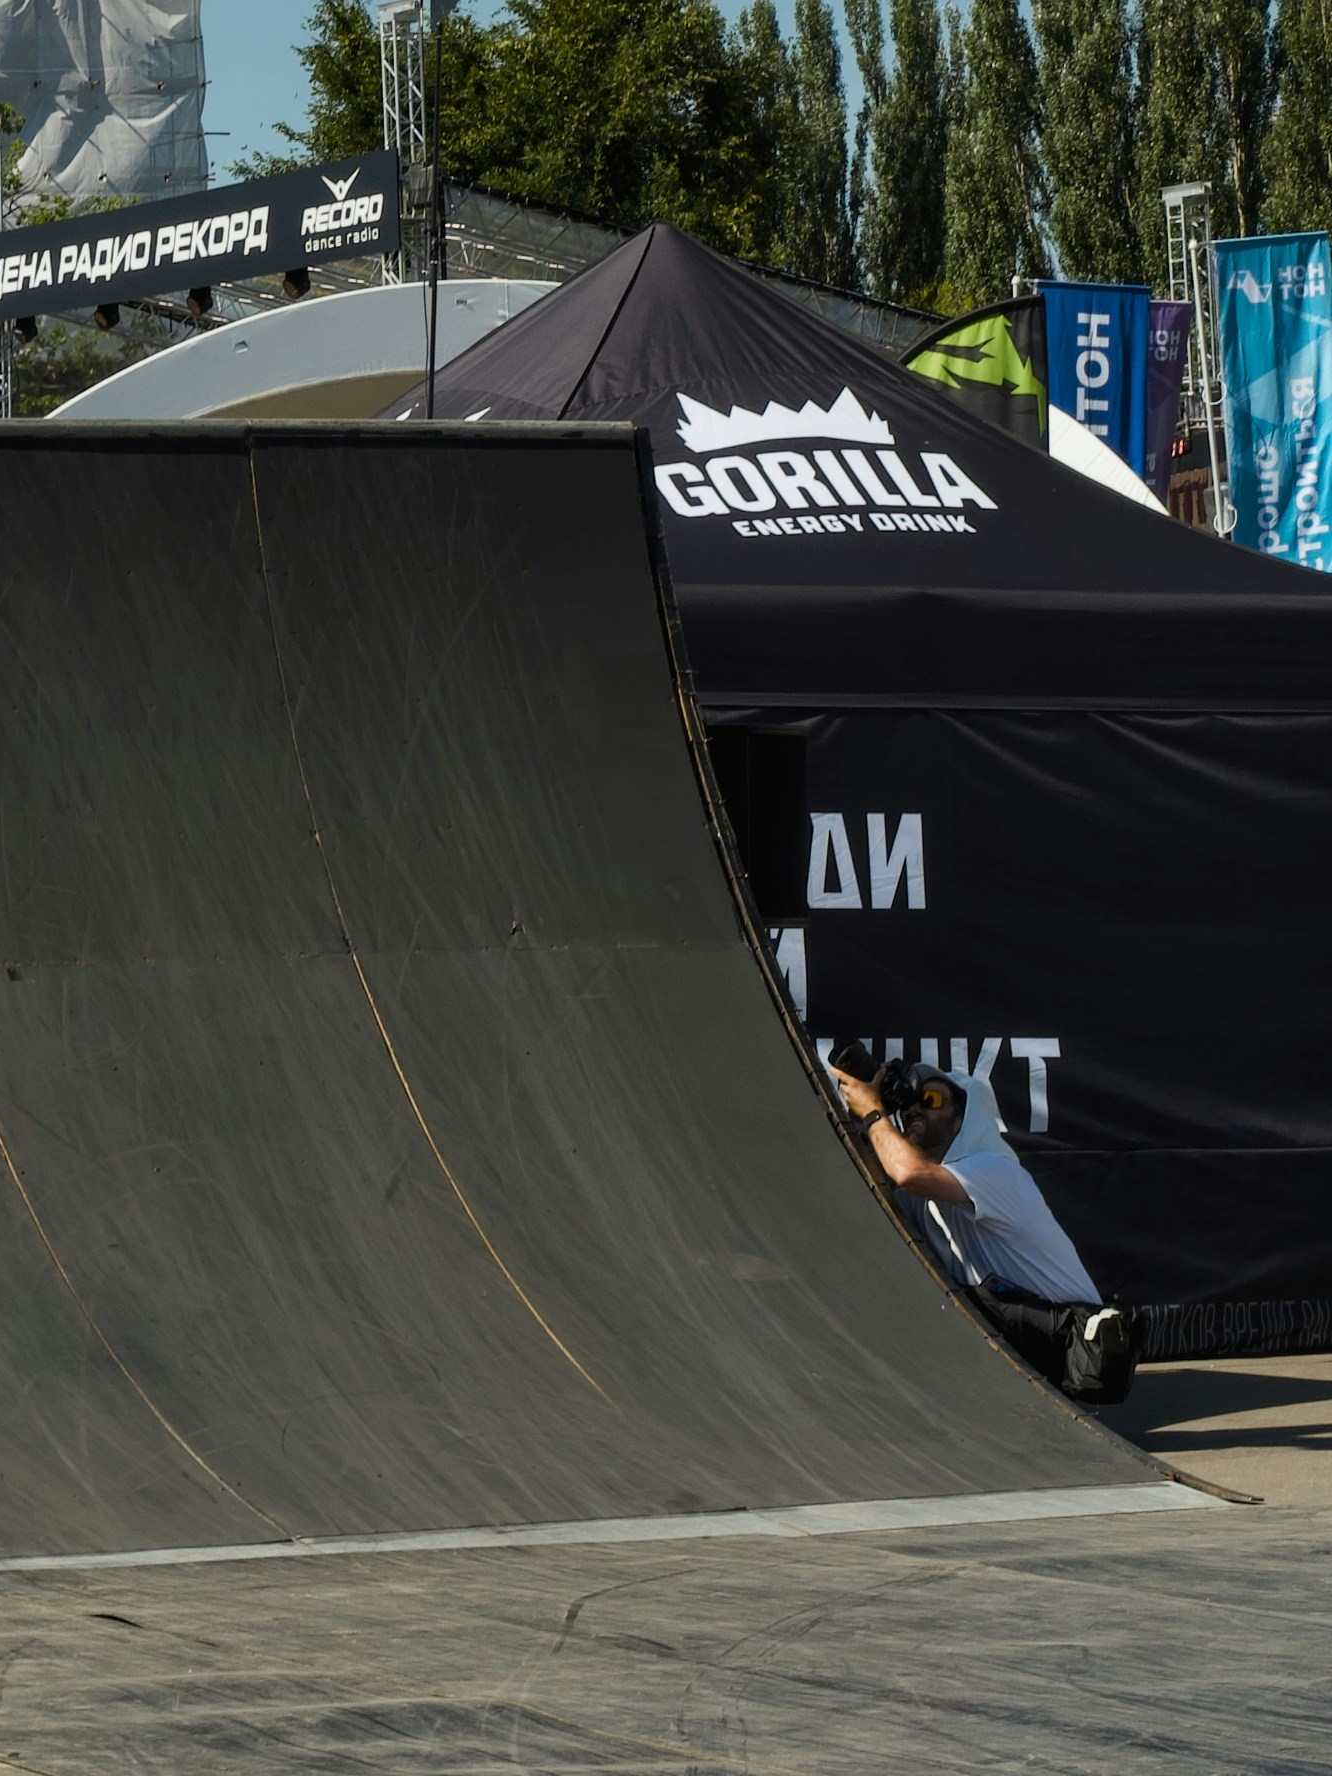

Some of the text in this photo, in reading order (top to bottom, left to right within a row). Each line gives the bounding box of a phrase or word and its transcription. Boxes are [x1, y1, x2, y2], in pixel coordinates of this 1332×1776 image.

[301, 193, 384, 236] RECORD
[305, 226, 379, 253] dance radio
[58, 230, 152, 284] РАДИО
[155, 206, 269, 266] РЕКОРД
[653, 449, 999, 518] GORILLA
[1291, 376, 1329, 572] троиться
[731, 512, 977, 538] ENERGY DRINK
